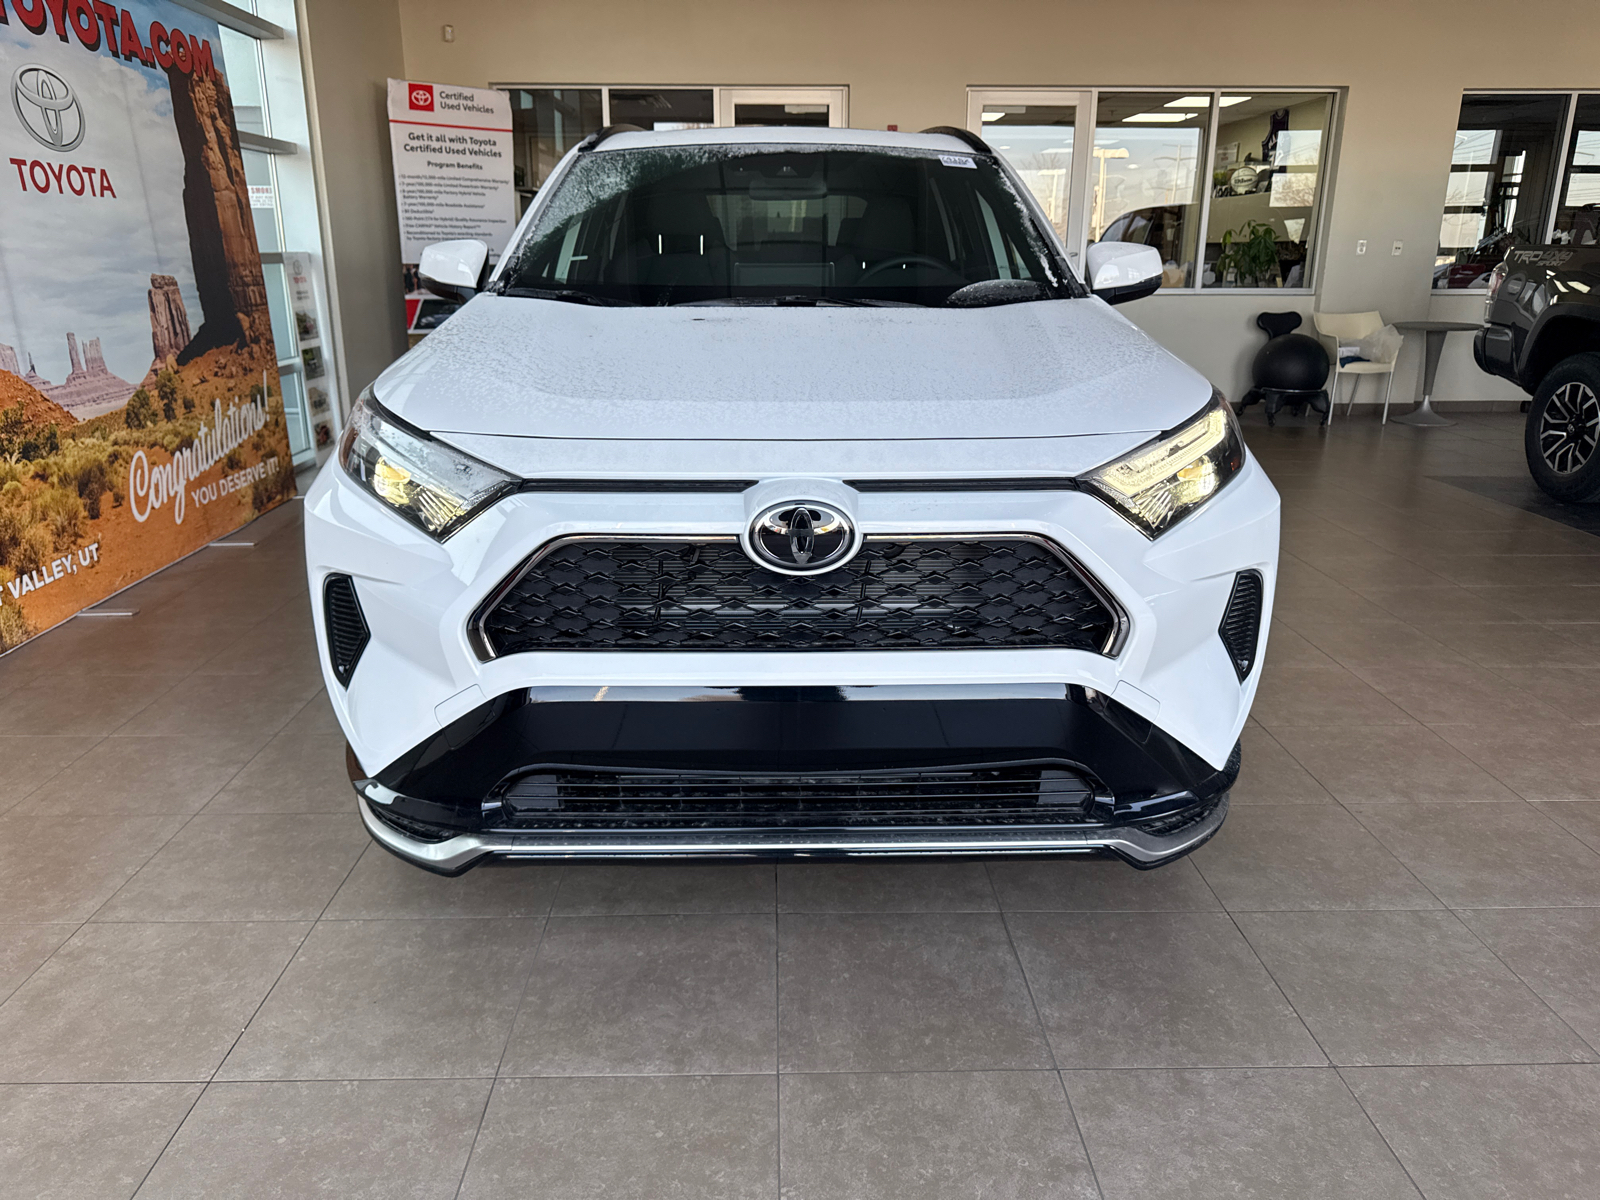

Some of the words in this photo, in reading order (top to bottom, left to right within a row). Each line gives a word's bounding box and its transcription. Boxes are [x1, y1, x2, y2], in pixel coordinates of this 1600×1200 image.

[0, 0, 216, 82] OYOTA.COM
[439, 91, 474, 101] Certified
[440, 101, 461, 111] Used
[462, 103, 494, 114] Vehicles
[408, 132, 425, 142] Get
[426, 133, 434, 143] it
[435, 134, 447, 144] all
[448, 136, 468, 145] with
[469, 137, 497, 147] Toyota
[404, 143, 443, 154] Certified
[445, 147, 467, 155] Used
[468, 148, 502, 158] Vehicles
[427, 161, 455, 169] Program
[457, 162, 483, 170] Benefits
[9, 158, 117, 199] TOYOTA
[1514, 251, 1543, 264] TRD
[129, 369, 270, 525] Congratulations!
[191, 483, 218, 508] YOU
[219, 462, 266, 497] DESERVE
[266, 456, 280, 475] IT!
[6, 554, 78, 600] VALLEY,
[78, 542, 99, 567] UT
